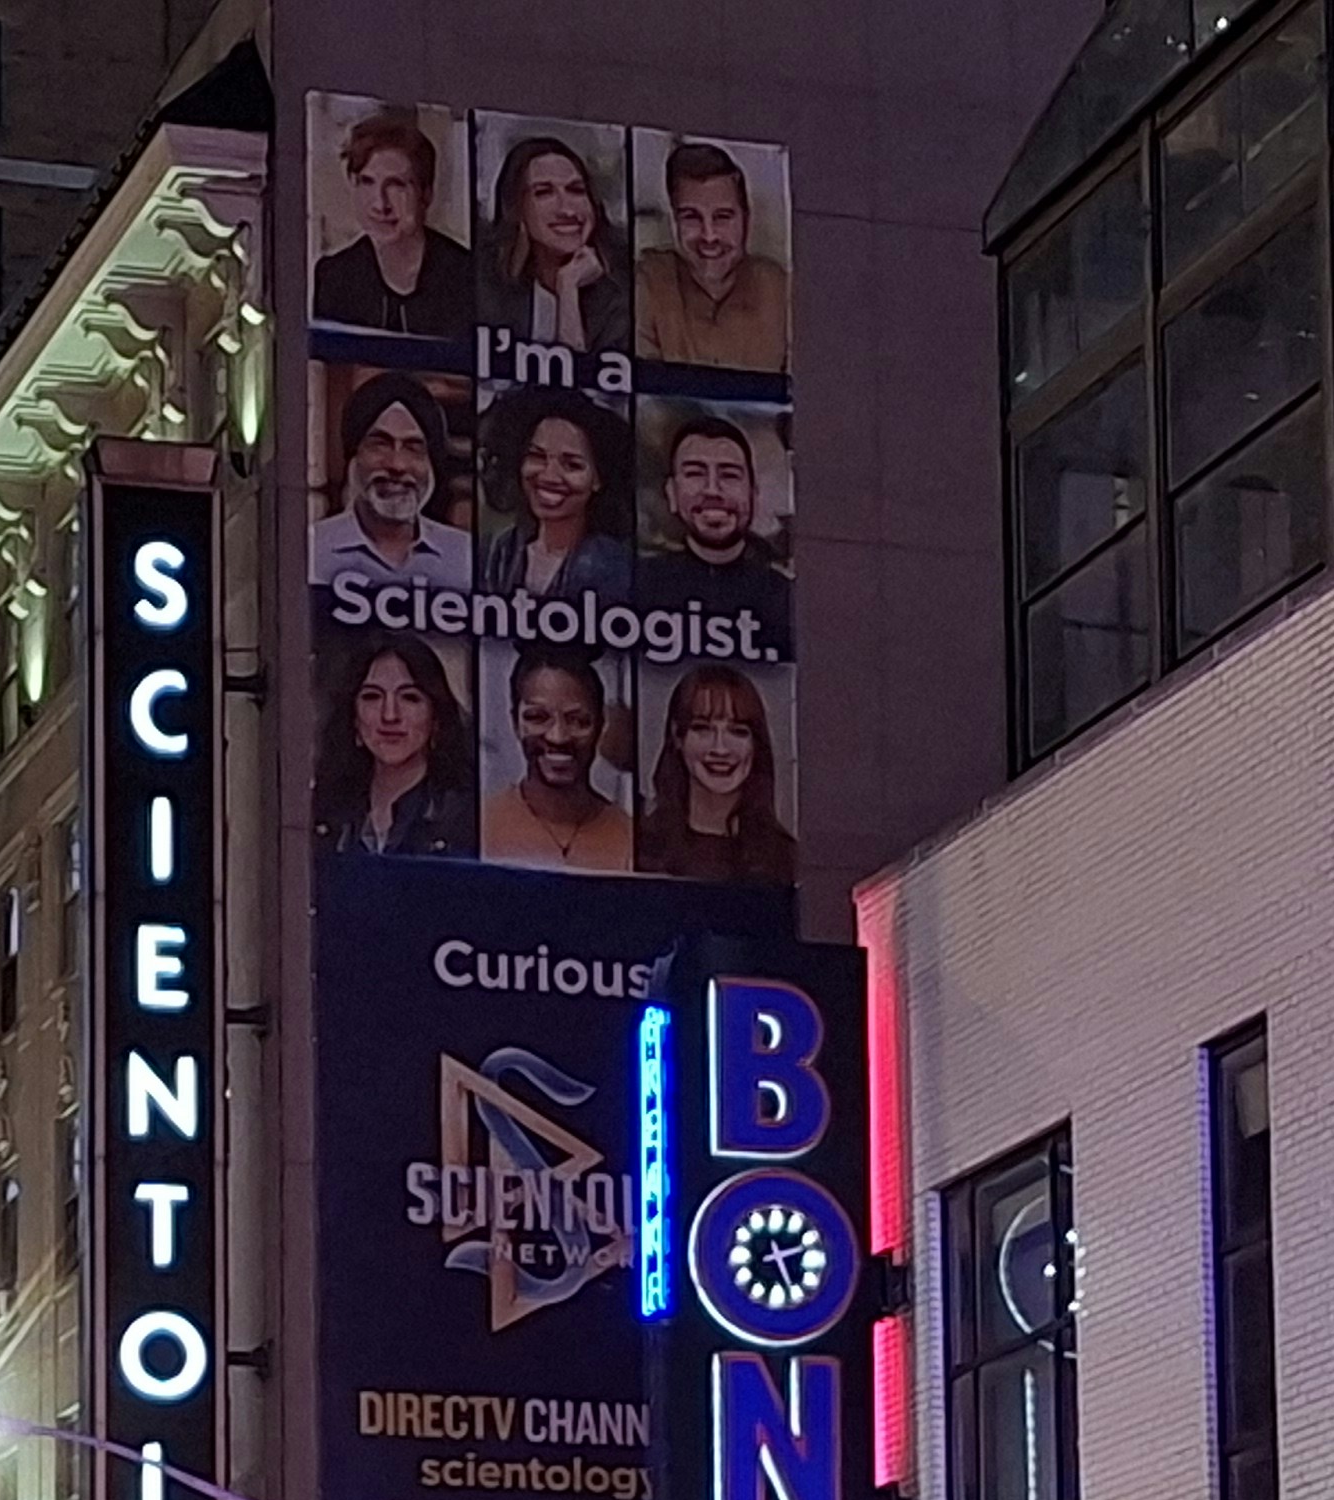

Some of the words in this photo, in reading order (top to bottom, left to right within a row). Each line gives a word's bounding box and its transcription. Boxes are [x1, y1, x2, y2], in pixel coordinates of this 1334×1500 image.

[476, 325, 576, 388] I'm
[595, 351, 634, 392] a
[331, 572, 781, 662] Scientologist.
[359, 1391, 516, 1440] DIRECTV
